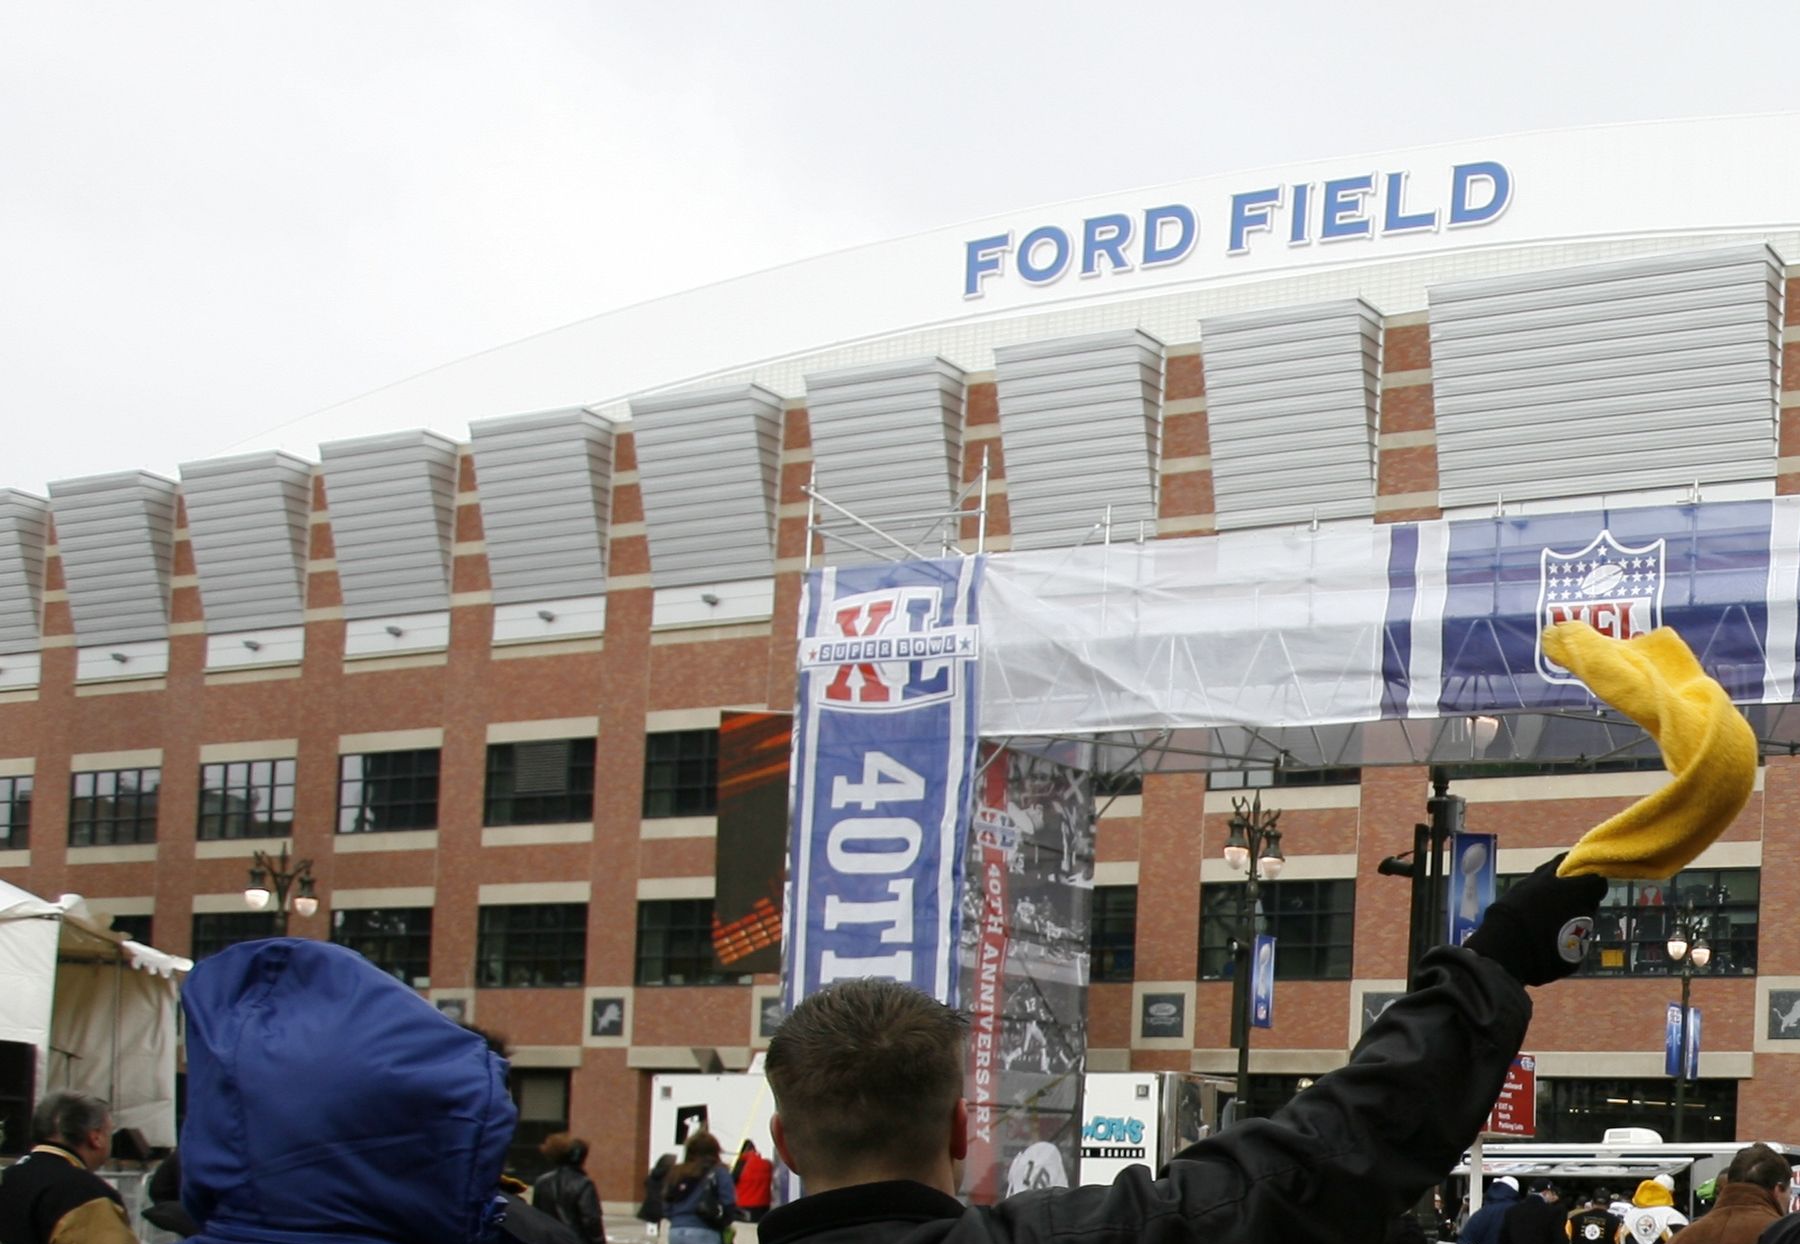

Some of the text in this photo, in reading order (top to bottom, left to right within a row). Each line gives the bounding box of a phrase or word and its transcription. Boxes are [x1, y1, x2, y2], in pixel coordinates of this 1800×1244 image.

[963, 160, 1515, 299] FORD FIELD
[820, 635, 955, 660] SUPER BOWL
[825, 598, 951, 703] XL
[975, 863, 1004, 1143] 40TH ANNIVERSARY
